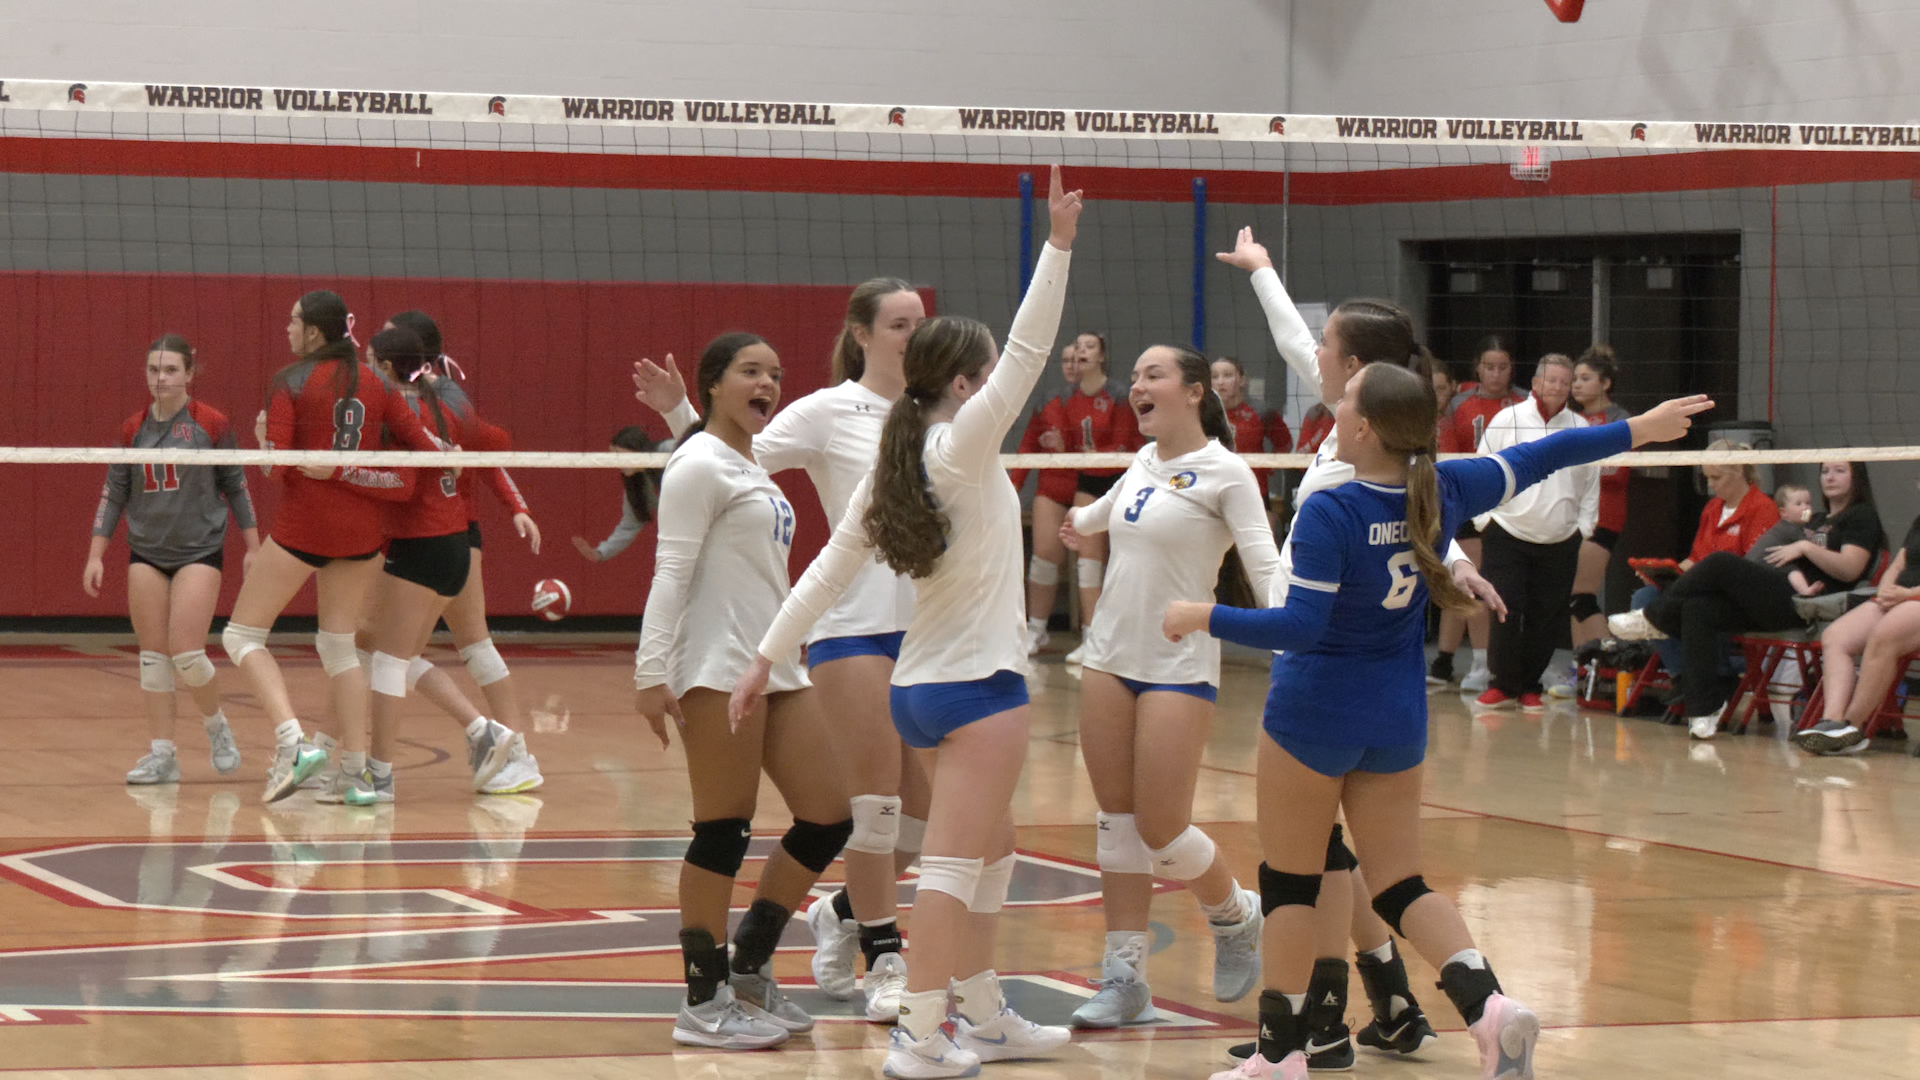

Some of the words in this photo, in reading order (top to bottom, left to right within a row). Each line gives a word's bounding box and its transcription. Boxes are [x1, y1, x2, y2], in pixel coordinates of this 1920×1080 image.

[145, 86, 262, 109] WARRIOR
[274, 90, 432, 114] VOLLEYBALL
[562, 98, 673, 120] WARRIOR
[685, 102, 835, 125] VOLLEYBALL
[959, 109, 1065, 131] WARRIOR
[1075, 112, 1218, 133] VOLLEYBALL
[1336, 118, 1437, 138] WARRIOR
[1447, 120, 1582, 140] VOLLEYBALL
[1695, 124, 1790, 143] WARRIOR
[1800, 126, 1920, 145] VOLLEYBAL
[332, 398, 365, 451] 8
[1124, 487, 1155, 523] 3
[769, 497, 792, 546] 12
[1368, 520, 1411, 546] ONEO
[1382, 550, 1420, 610] 6
